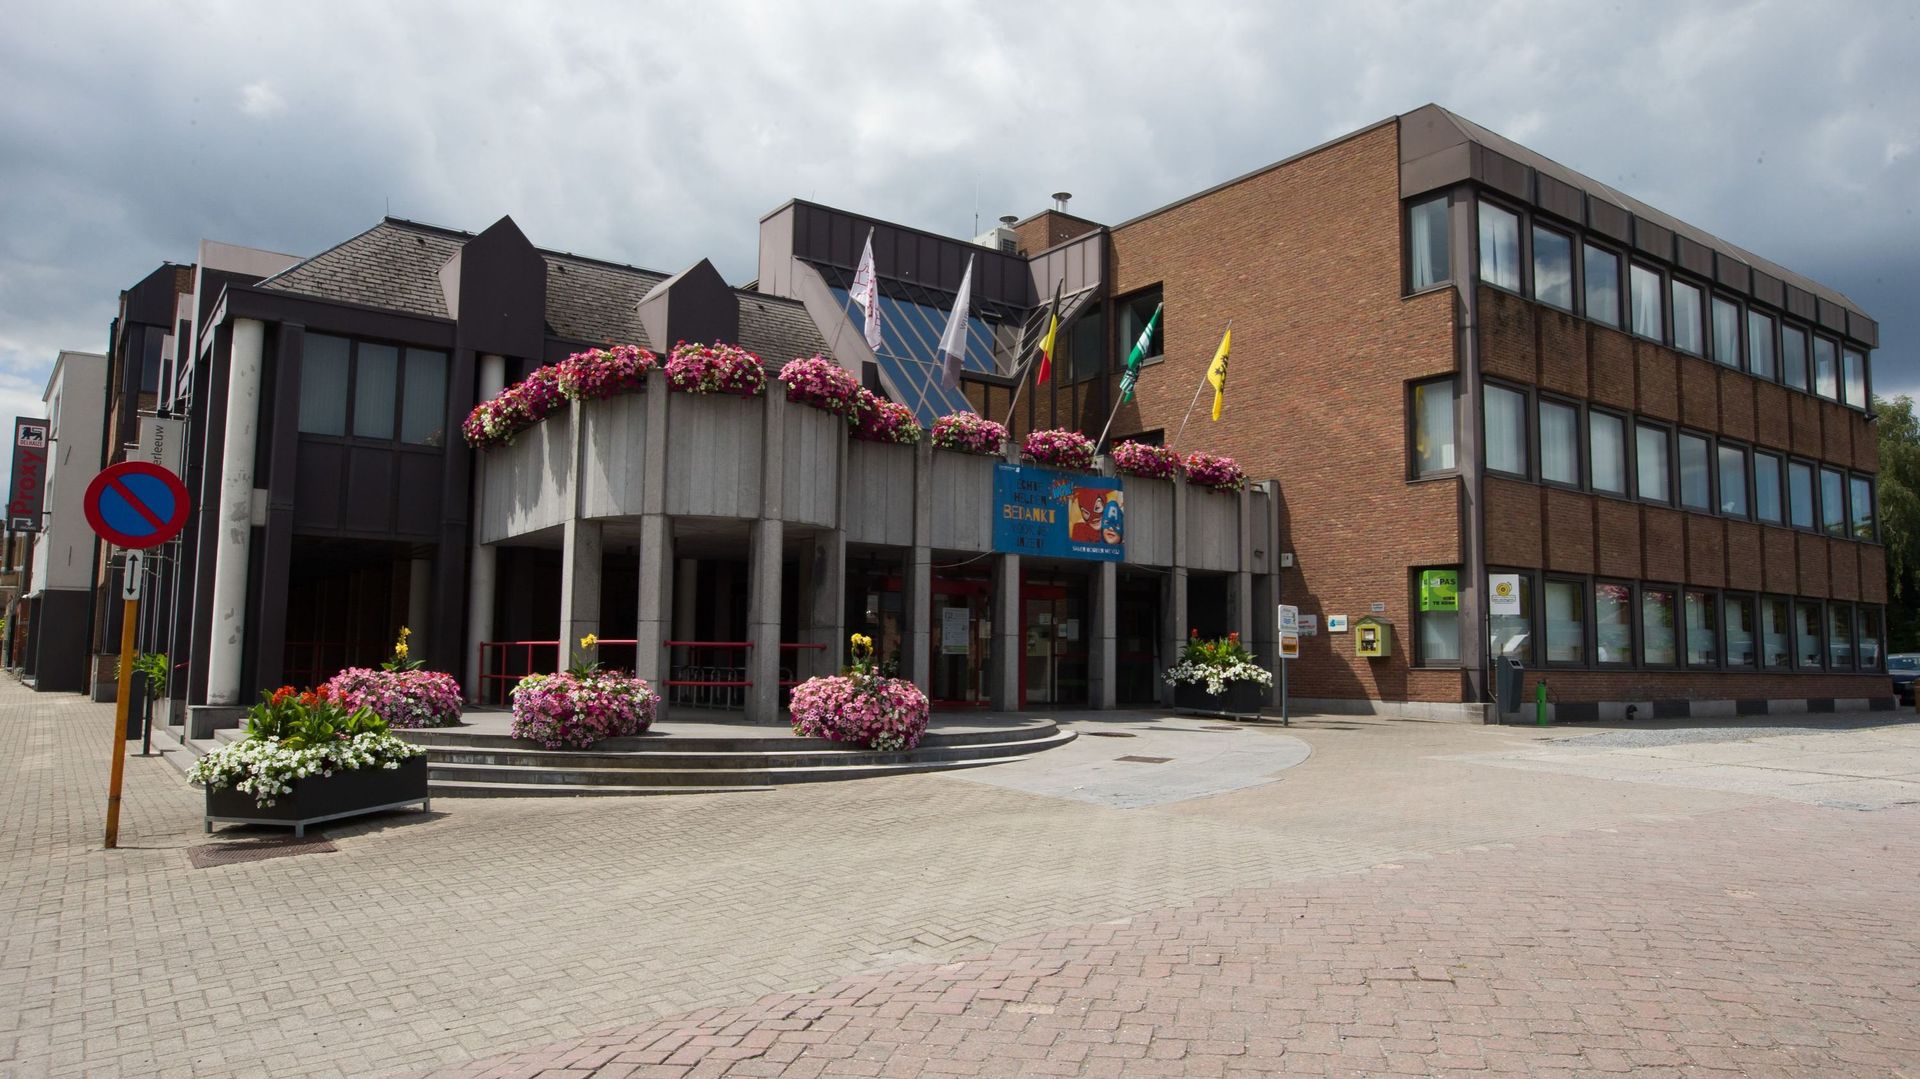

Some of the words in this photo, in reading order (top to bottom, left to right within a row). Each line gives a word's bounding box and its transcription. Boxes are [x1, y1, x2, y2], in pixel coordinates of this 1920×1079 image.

[20, 439, 43, 448] DELHAIZE
[10, 450, 44, 516] Proxy
[1003, 503, 1056, 524] BEDANKT
